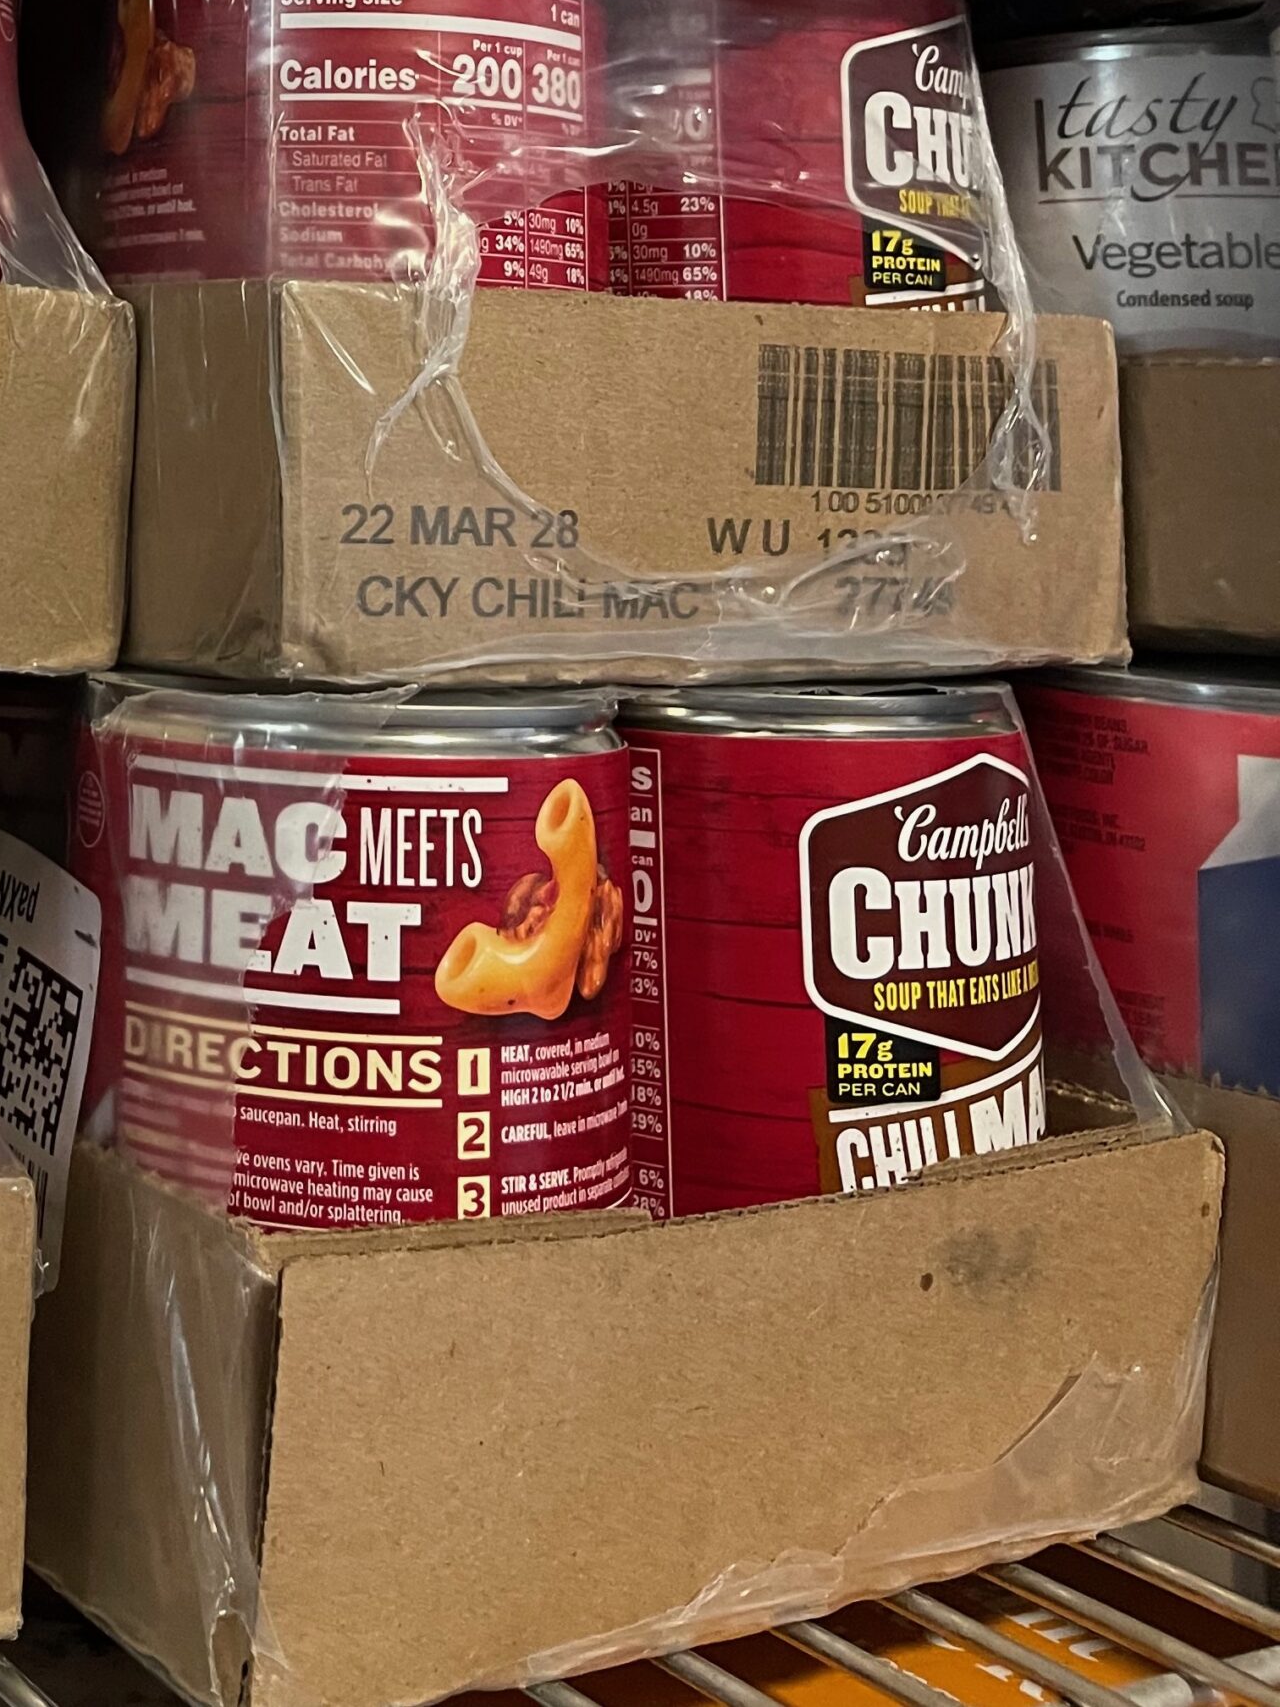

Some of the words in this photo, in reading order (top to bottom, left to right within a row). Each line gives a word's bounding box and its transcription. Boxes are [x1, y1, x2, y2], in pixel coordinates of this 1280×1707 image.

[279, 58, 417, 91] Calories
[452, 54, 522, 100] 200
[532, 63, 581, 109] 380
[279, 125, 323, 143] Total
[328, 126, 355, 143] Fat
[1035, 99, 1280, 192] KITCHE
[292, 149, 361, 169] Saturated
[680, 197, 715, 213] 23%
[495, 234, 524, 252] 34%
[632, 245, 669, 264] 30mg
[683, 243, 716, 259] 10%
[871, 230, 914, 255] 17g
[529, 263, 548, 283] 49g
[682, 264, 717, 282] 65%
[872, 255, 941, 273] PROTEIN
[872, 272, 902, 285] PER
[904, 273, 933, 286] CAN
[1116, 290, 1211, 308] Condensed
[1215, 293, 1254, 311] soup
[340, 504, 393, 546] 22
[410, 504, 517, 547] MAR
[530, 508, 579, 549] 28
[708, 517, 749, 557] W
[764, 519, 791, 558] U
[357, 576, 462, 619] CKY
[471, 578, 587, 621] CHILI
[604, 580, 699, 622] MAC
[129, 784, 347, 884] MAC
[360, 807, 483, 888] MEETS
[125, 876, 421, 982] MEAT
[828, 863, 1038, 981] CHUNK
[873, 980, 923, 1012] SOUP
[926, 977, 966, 1009] THAT
[970, 974, 1000, 1005] EATS
[125, 1014, 442, 1093] DIRECTIONS
[501, 1045, 533, 1064] HEAT,
[535, 1039, 573, 1060] covered,
[837, 1032, 893, 1062] 17g
[501, 1061, 570, 1084] microwavable
[837, 1061, 932, 1079] PROTEIN
[501, 1088, 529, 1107] HIGH
[838, 1082, 875, 1097] PER
[881, 1082, 921, 1096] CAN
[240, 1105, 305, 1127] saucepan.
[309, 1111, 344, 1133] Heat,
[348, 1115, 397, 1137] stirring
[501, 1124, 552, 1144] CAREFUL,
[254, 1154, 291, 1171] ovens
[295, 1160, 327, 1178] vary.
[332, 1159, 364, 1178] Time
[368, 1162, 405, 1182] given
[234, 1172, 304, 1195] microwave
[308, 1179, 359, 1203] heating
[363, 1186, 392, 1204] may
[396, 1187, 433, 1203] cause
[244, 1193, 276, 1213] bowl
[279, 1199, 324, 1218] and/or
[501, 1195, 541, 1216] unused
